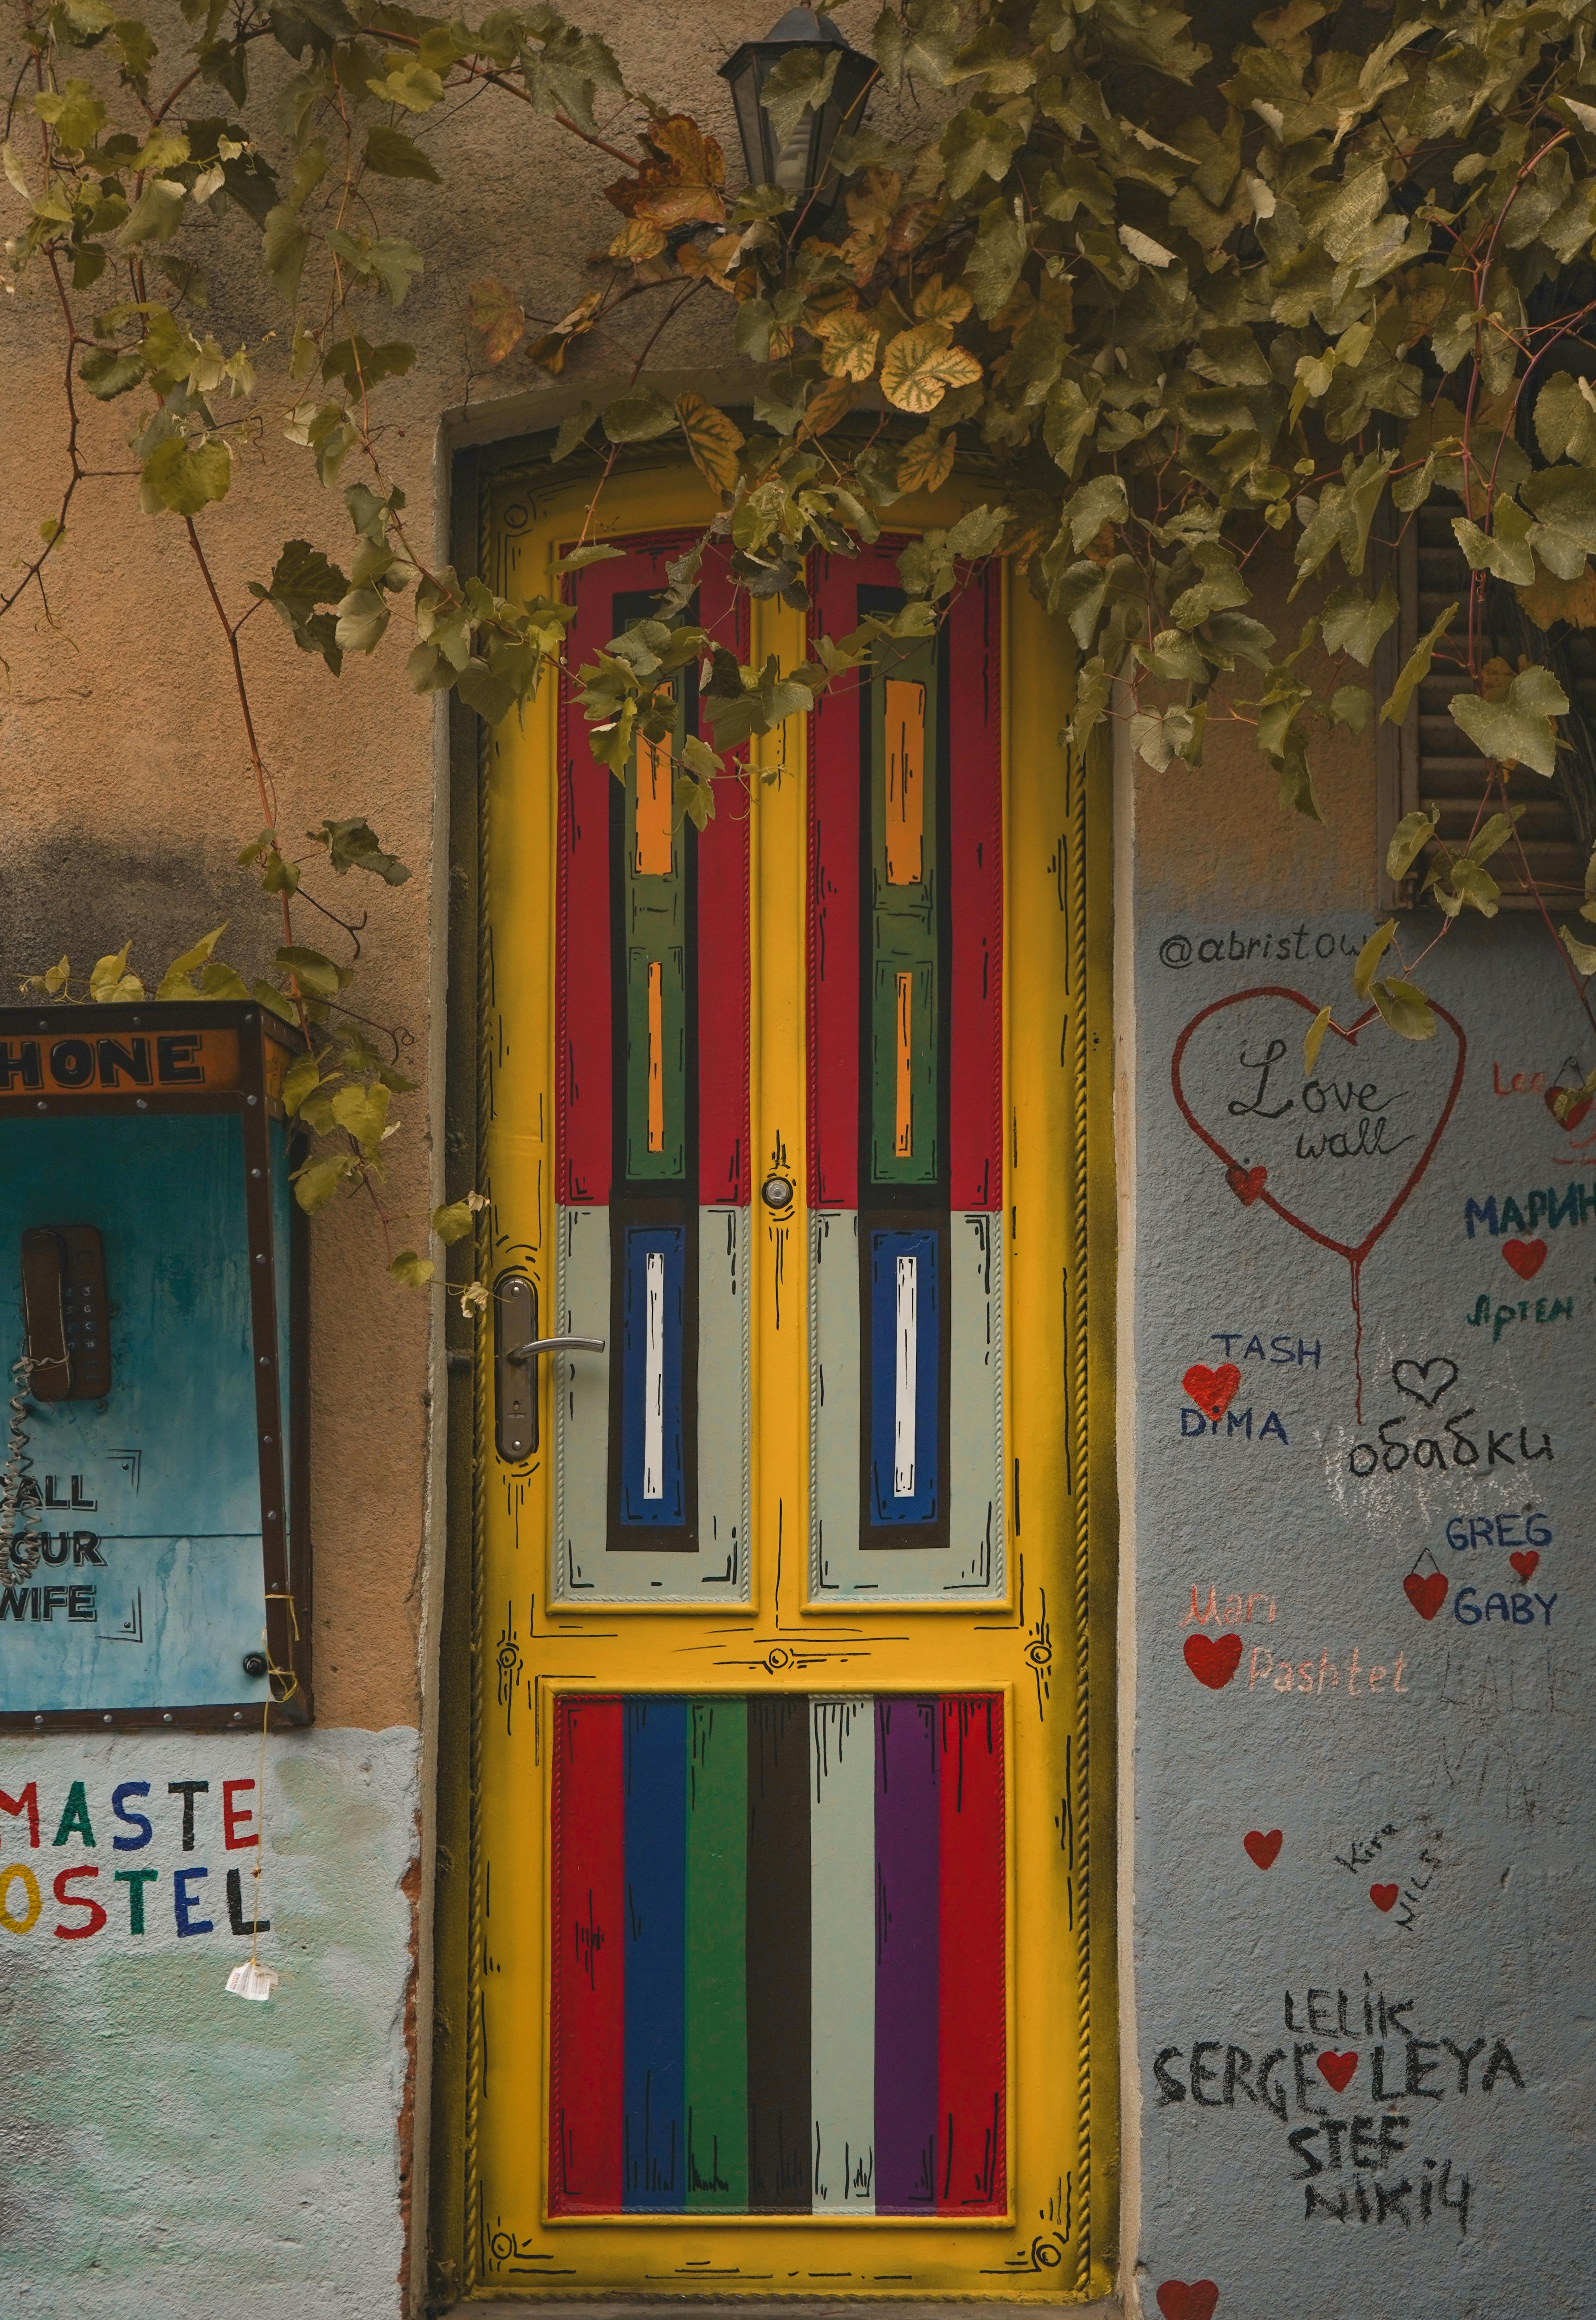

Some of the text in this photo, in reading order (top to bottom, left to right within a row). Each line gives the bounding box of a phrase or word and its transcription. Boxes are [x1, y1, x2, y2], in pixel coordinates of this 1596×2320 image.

[1160, 924, 1391, 969] @abristow
[0, 1034, 205, 1090] HONE
[1228, 1039, 1409, 1118] Love
[1295, 1117, 1419, 1160] wall
[1211, 1334, 1321, 1369] TASH
[1446, 1513, 1553, 1551] GREG
[0, 1585, 97, 1622] WIFE
[1454, 1586, 1557, 1626] GABY
[1249, 1646, 1410, 1696] Pashtet
[0, 1779, 259, 1851] MASTE
[0, 1863, 270, 1940] OSTEL
[1153, 2036, 1526, 2122] SERGE LEYA
[1287, 2115, 1410, 2181] STEF
